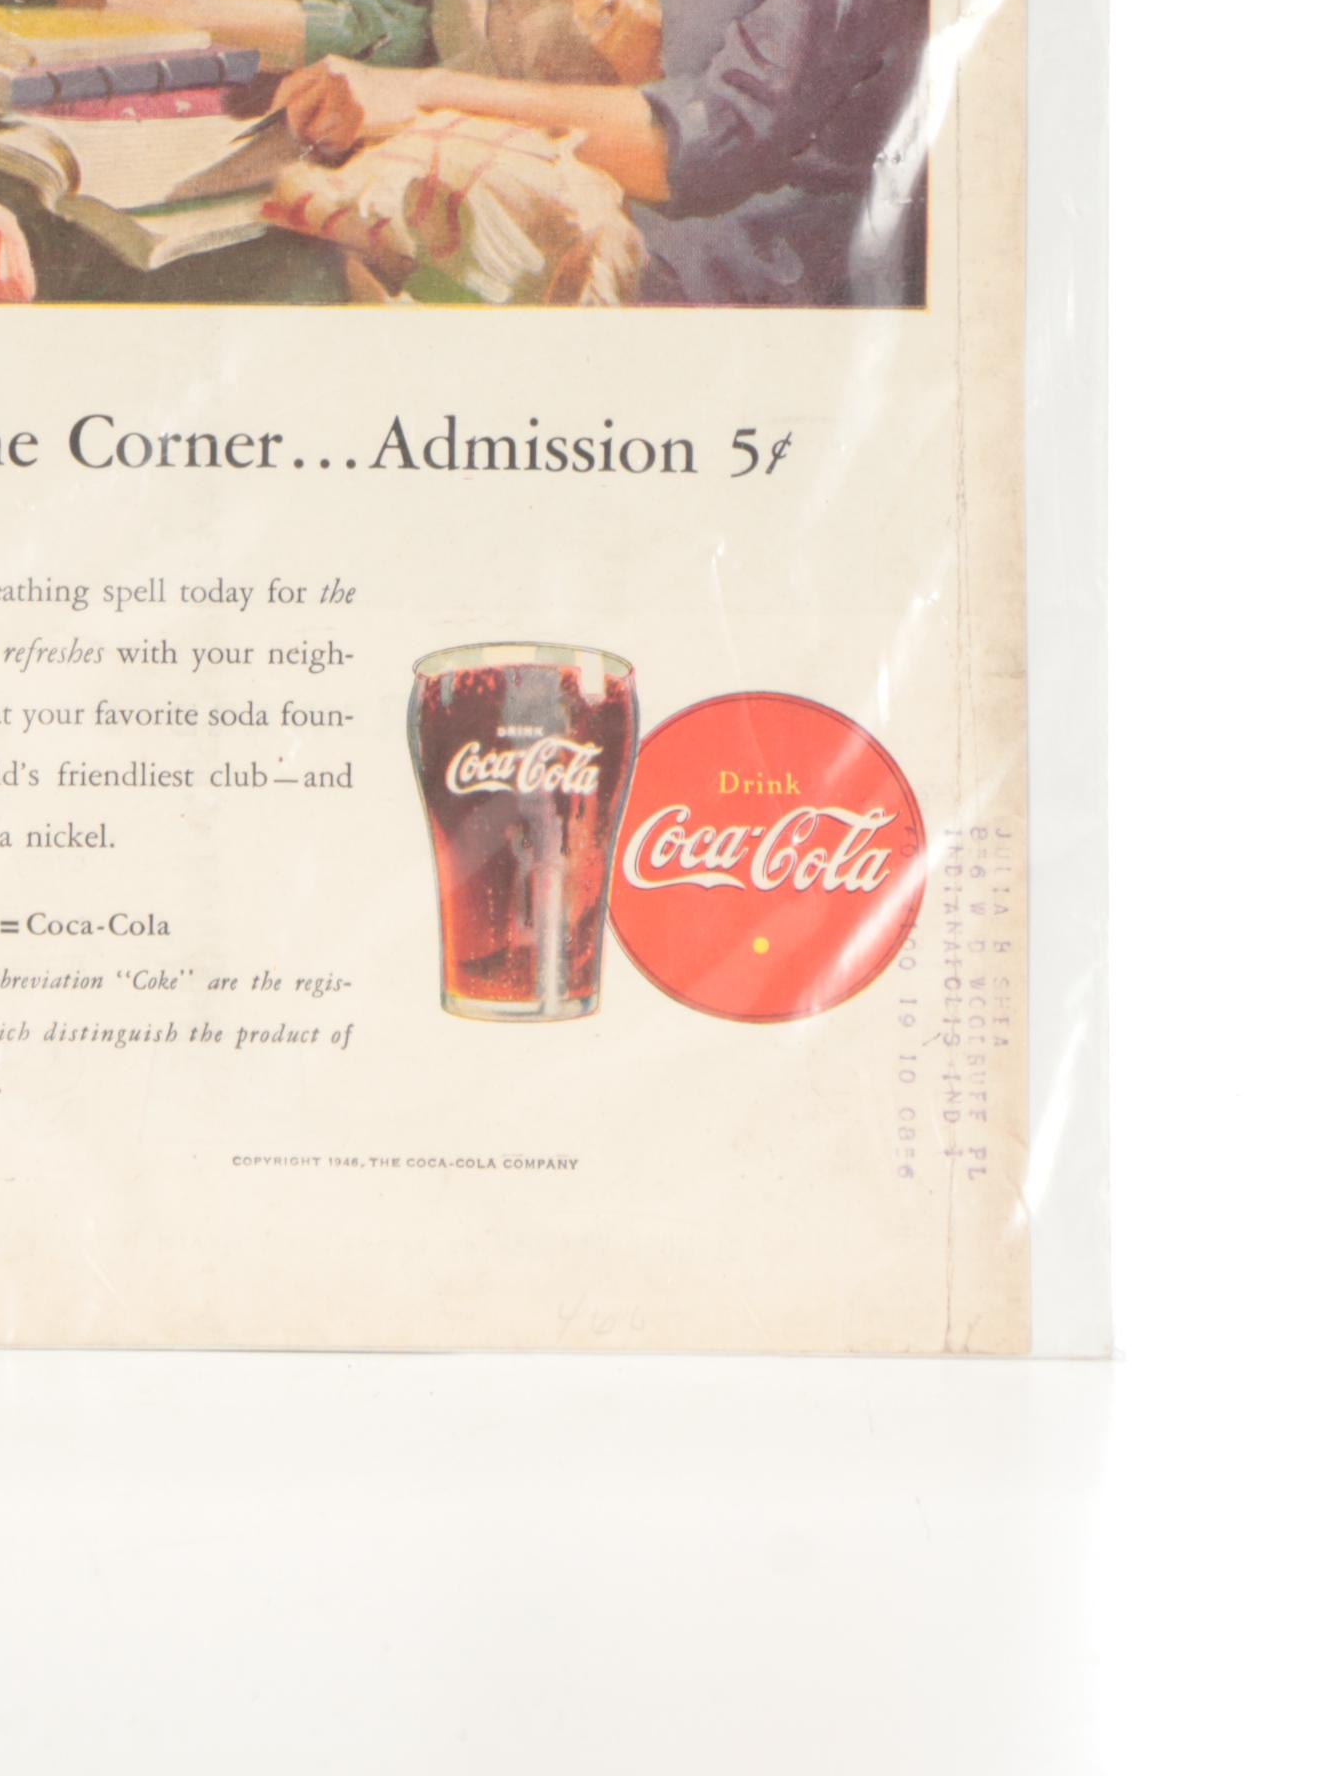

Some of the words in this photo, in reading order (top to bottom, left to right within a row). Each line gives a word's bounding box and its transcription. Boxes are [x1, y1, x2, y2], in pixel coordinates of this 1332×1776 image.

[730, 427, 793, 479] 5¢
[102, 577, 166, 613] spell
[180, 576, 255, 613] today
[267, 576, 308, 605] for
[319, 576, 357, 605] the
[3, 636, 105, 673] refreshes
[116, 638, 178, 665] with
[191, 646, 255, 674] your
[267, 639, 354, 675] neigh-
[22, 708, 85, 734] your
[94, 698, 199, 727] favorite
[207, 699, 270, 727] soda
[280, 699, 355, 728] foun-
[497, 726, 544, 738] DRINK
[57, 760, 195, 788] friendliest
[718, 770, 801, 795] Drink
[622, 804, 901, 893] Coca-Cola
[206, 976, 239, 992] are
[250, 969, 283, 992] the
[42, 1020, 179, 1049] distinguish
[188, 1020, 224, 1044] the
[234, 1022, 321, 1051] product
[330, 1022, 355, 1051] of
[231, 1155, 323, 1168] COPYRIGHT
[369, 1156, 402, 1168] THE
[405, 1157, 498, 1170] COCA-COLA
[502, 1156, 580, 1171] COMPANY
